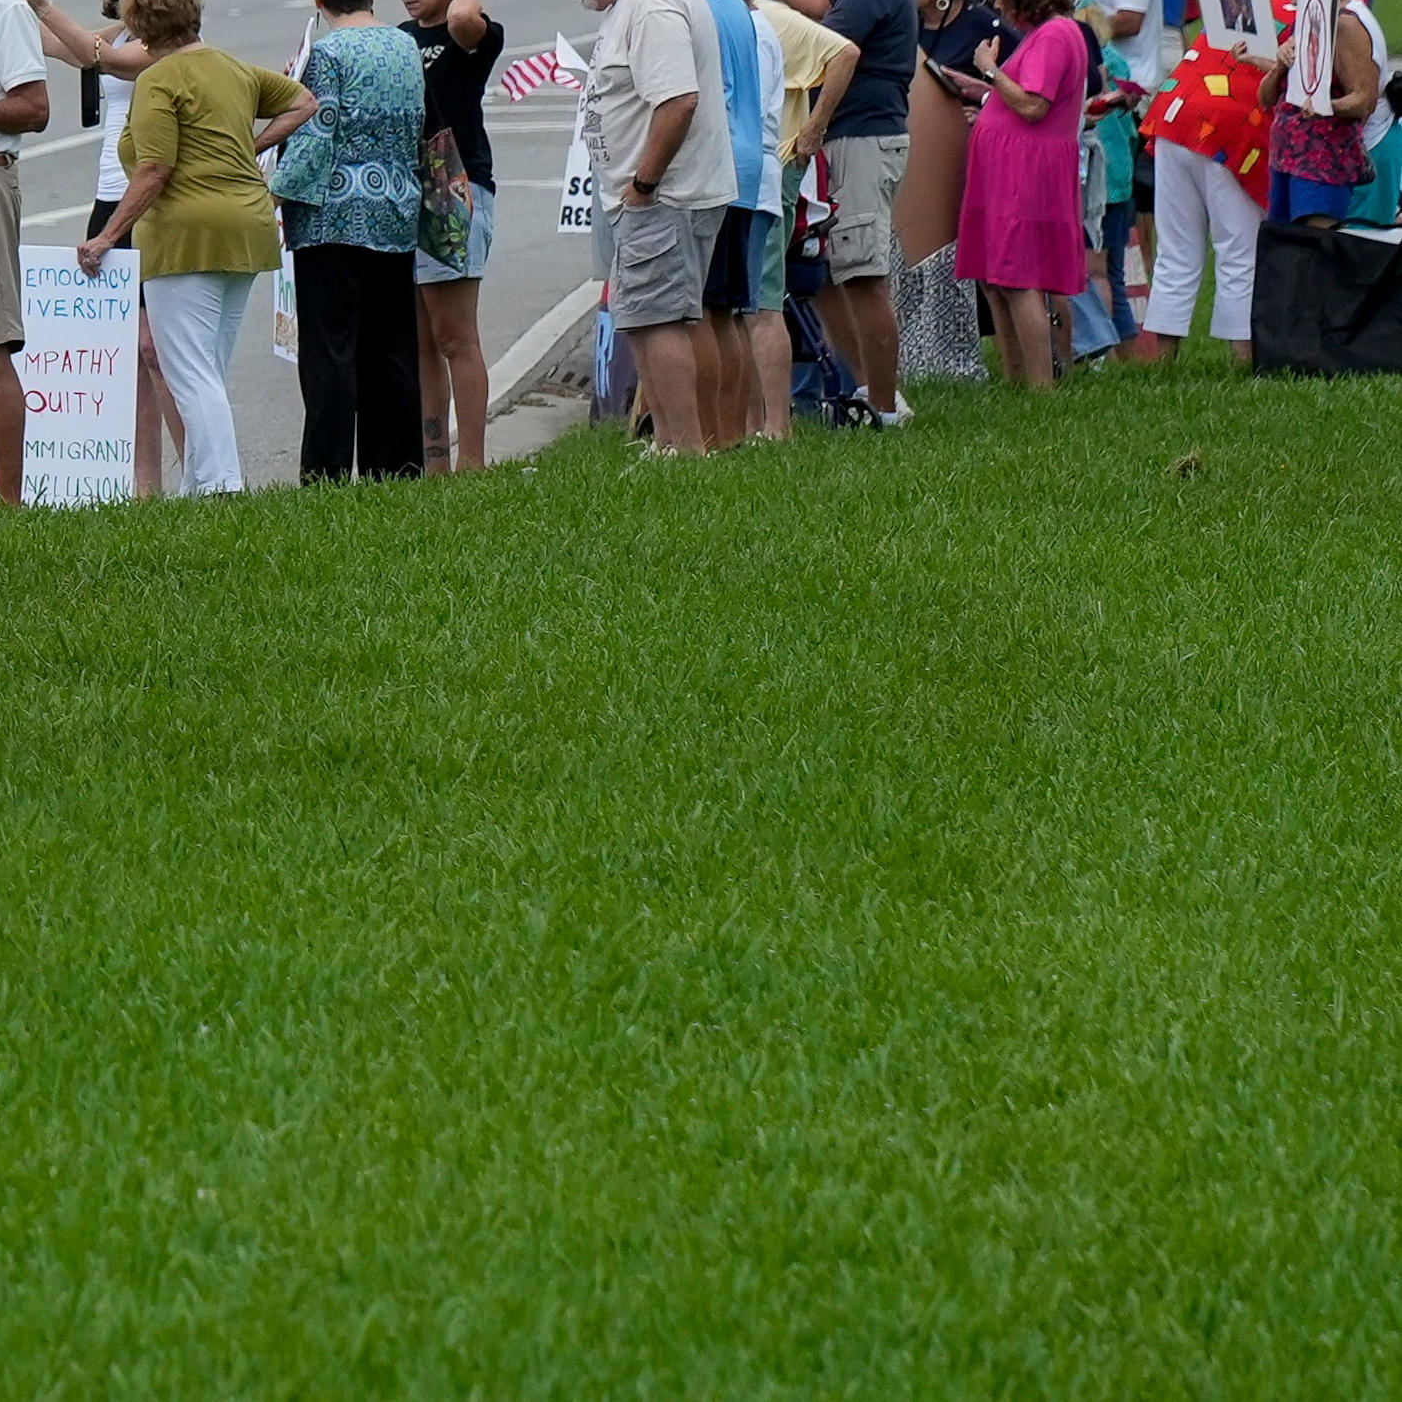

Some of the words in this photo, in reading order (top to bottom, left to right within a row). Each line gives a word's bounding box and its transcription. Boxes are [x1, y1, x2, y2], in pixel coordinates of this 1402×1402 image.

[27, 297, 131, 321] IVERSITY
[24, 347, 120, 376] MPATHY
[25, 439, 132, 464] MMIGRANTS
